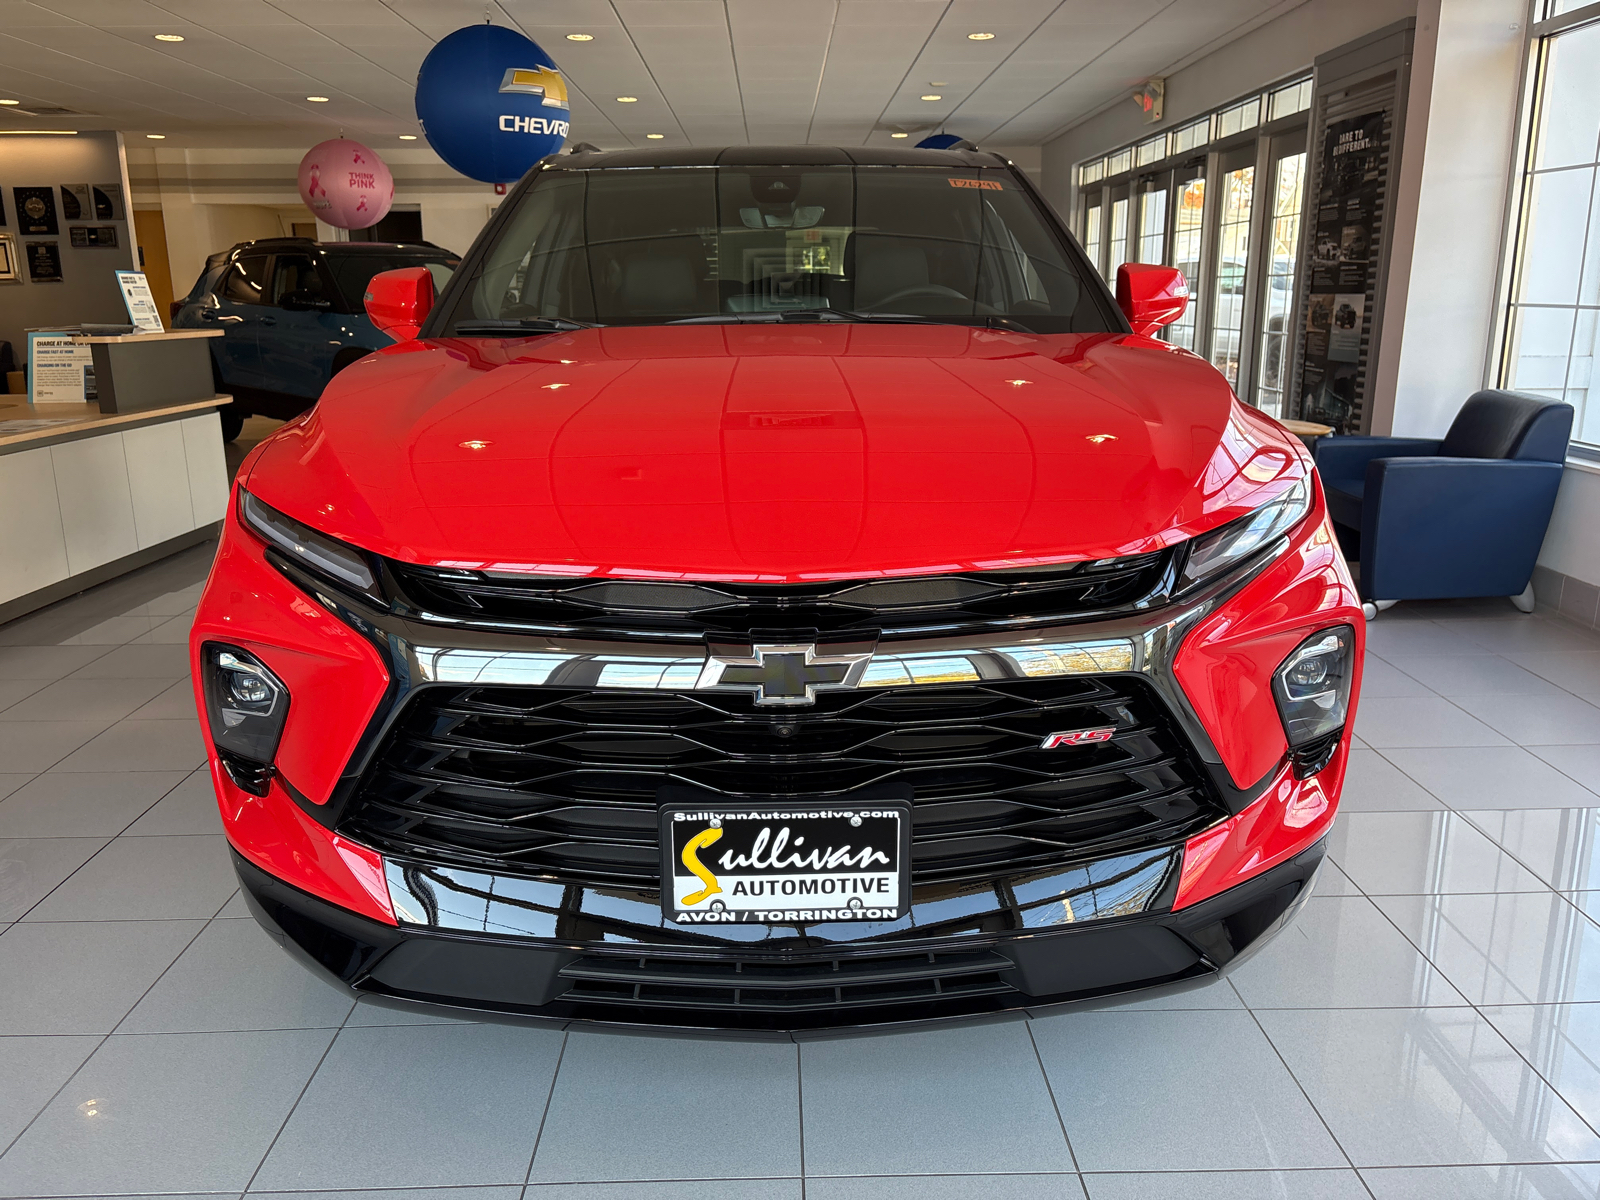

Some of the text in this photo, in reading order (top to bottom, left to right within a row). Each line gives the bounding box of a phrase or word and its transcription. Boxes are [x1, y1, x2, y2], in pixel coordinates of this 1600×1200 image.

[1354, 129, 1364, 140] TO
[348, 172, 375, 180] THINK
[349, 179, 375, 189] PINK
[1041, 727, 1117, 749] RS
[673, 810, 899, 821] SullivanAutomotive.com
[681, 826, 890, 906] Sullivan
[732, 877, 890, 896] AUTOMOTIVE
[676, 911, 736, 922] AVON
[754, 908, 897, 921] TORRINGTON
